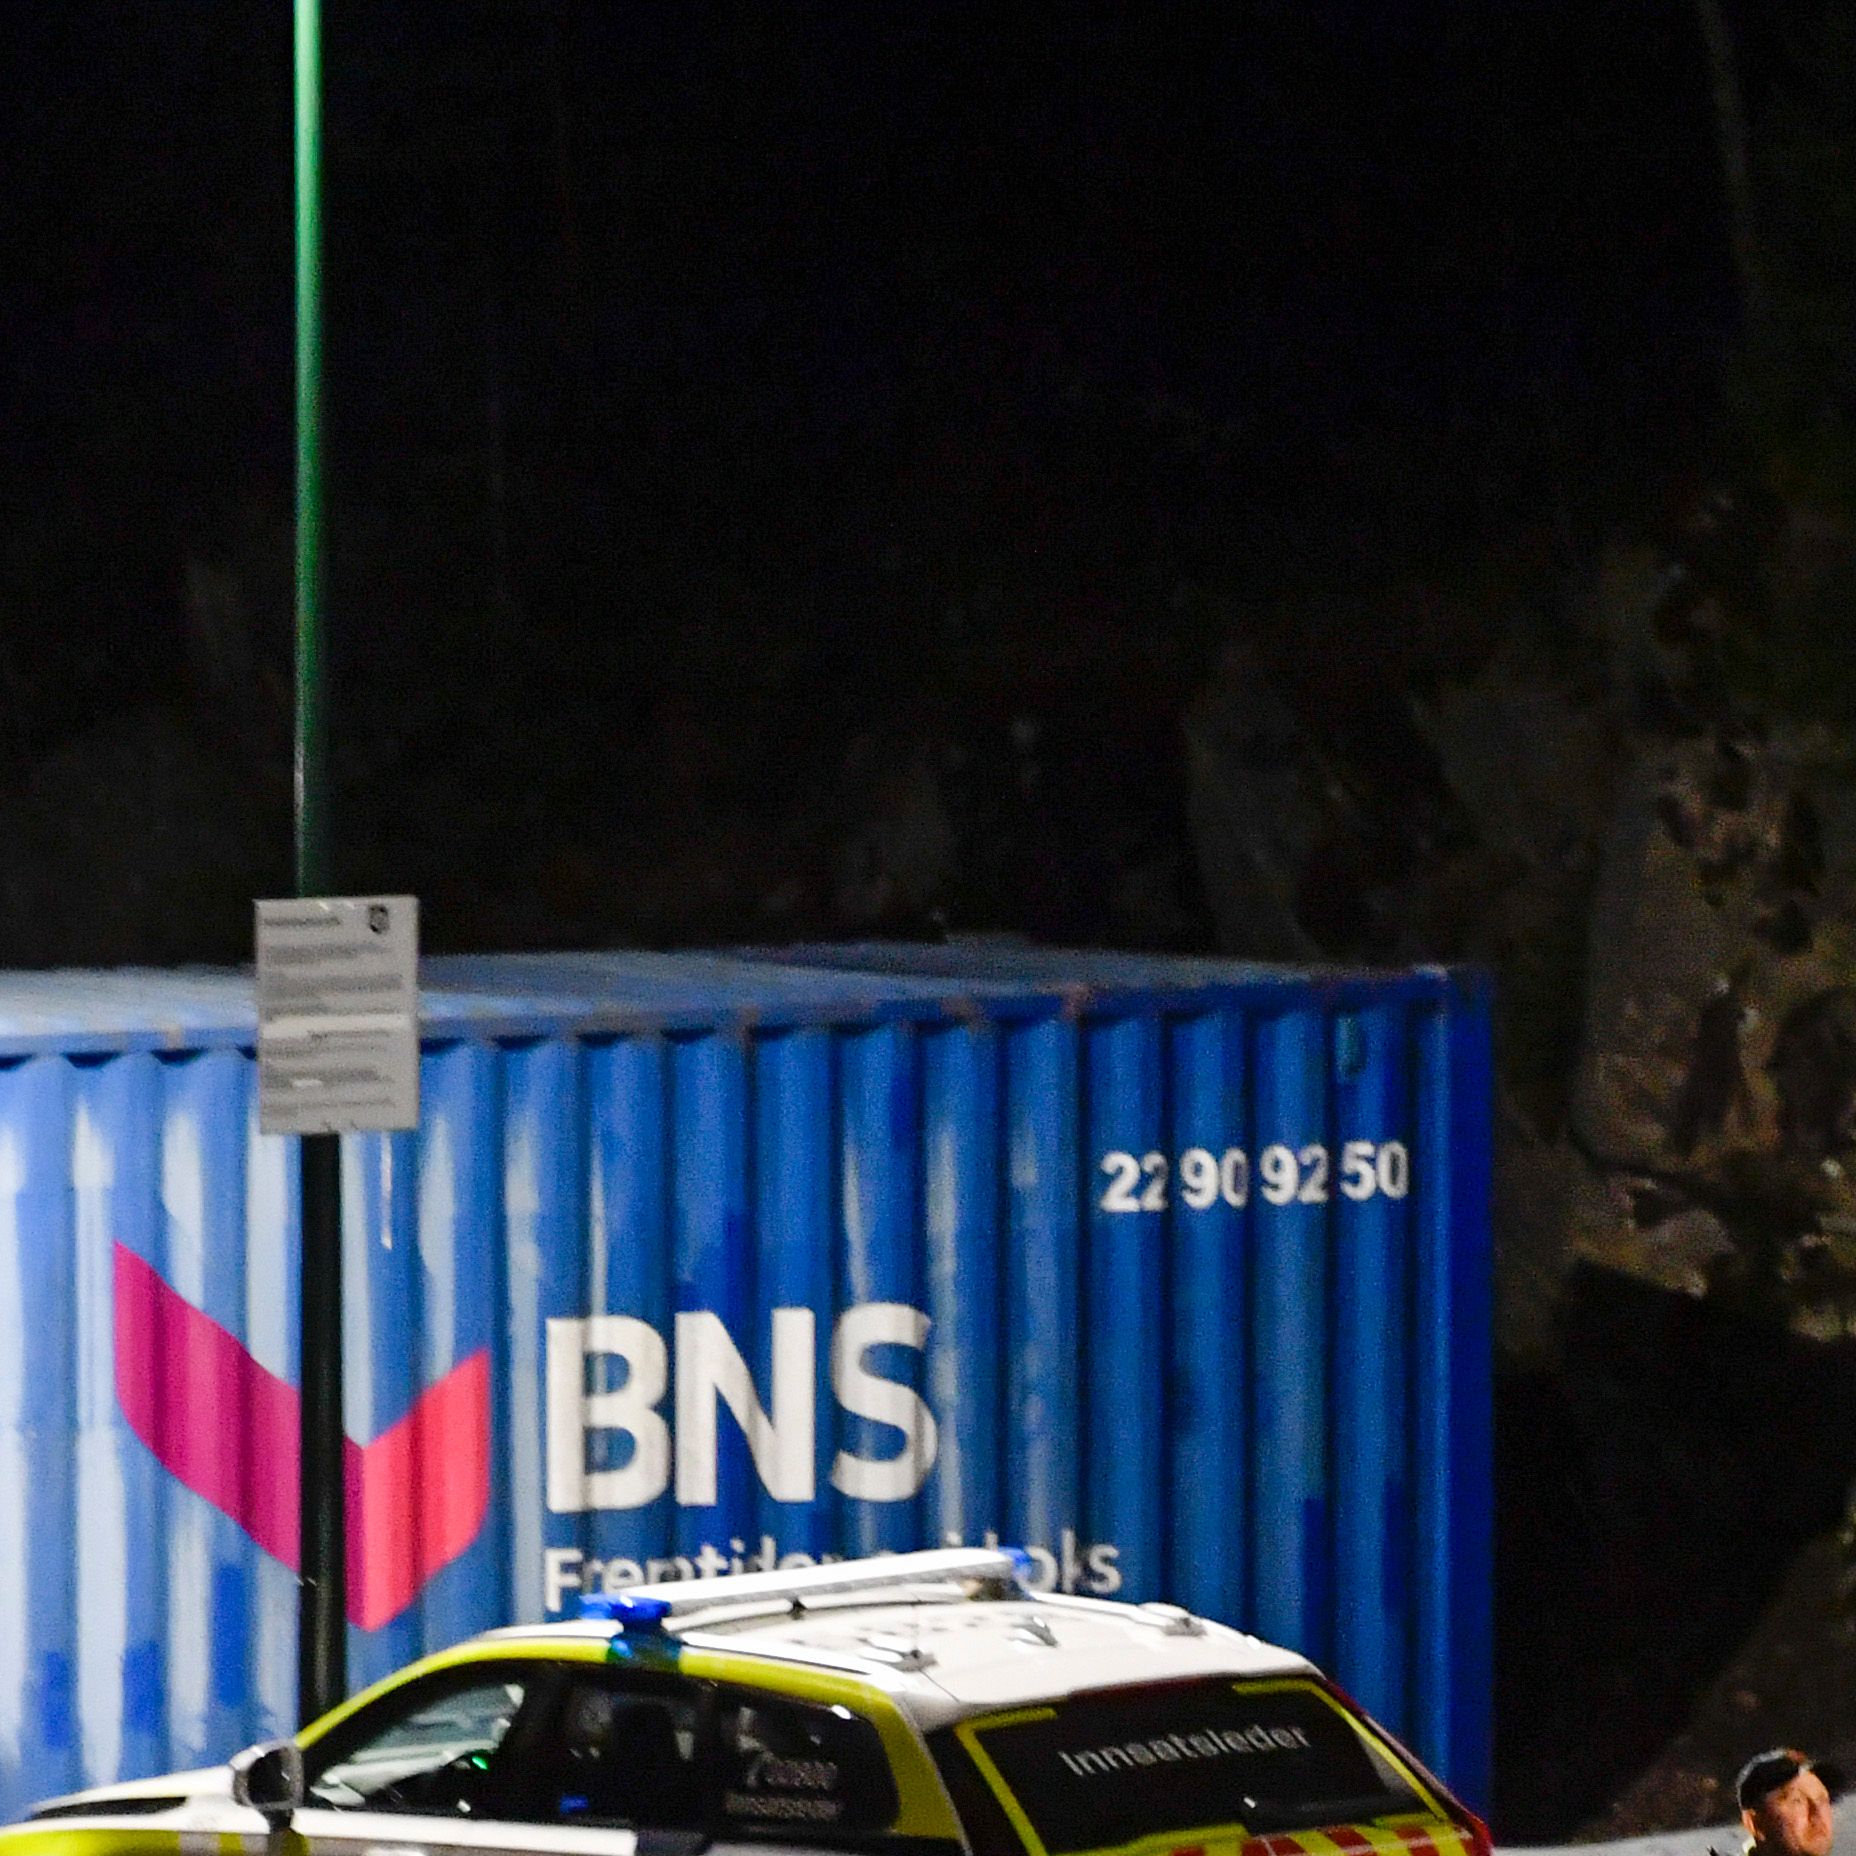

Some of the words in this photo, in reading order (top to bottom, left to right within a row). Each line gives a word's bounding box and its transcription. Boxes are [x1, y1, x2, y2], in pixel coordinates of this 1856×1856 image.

[1100, 1150, 1169, 1213] 22
[1180, 1147, 1250, 1210] 90
[1259, 1142, 1330, 1205] 92
[1340, 1140, 1409, 1201] 50
[546, 1303, 938, 1513] BNS
